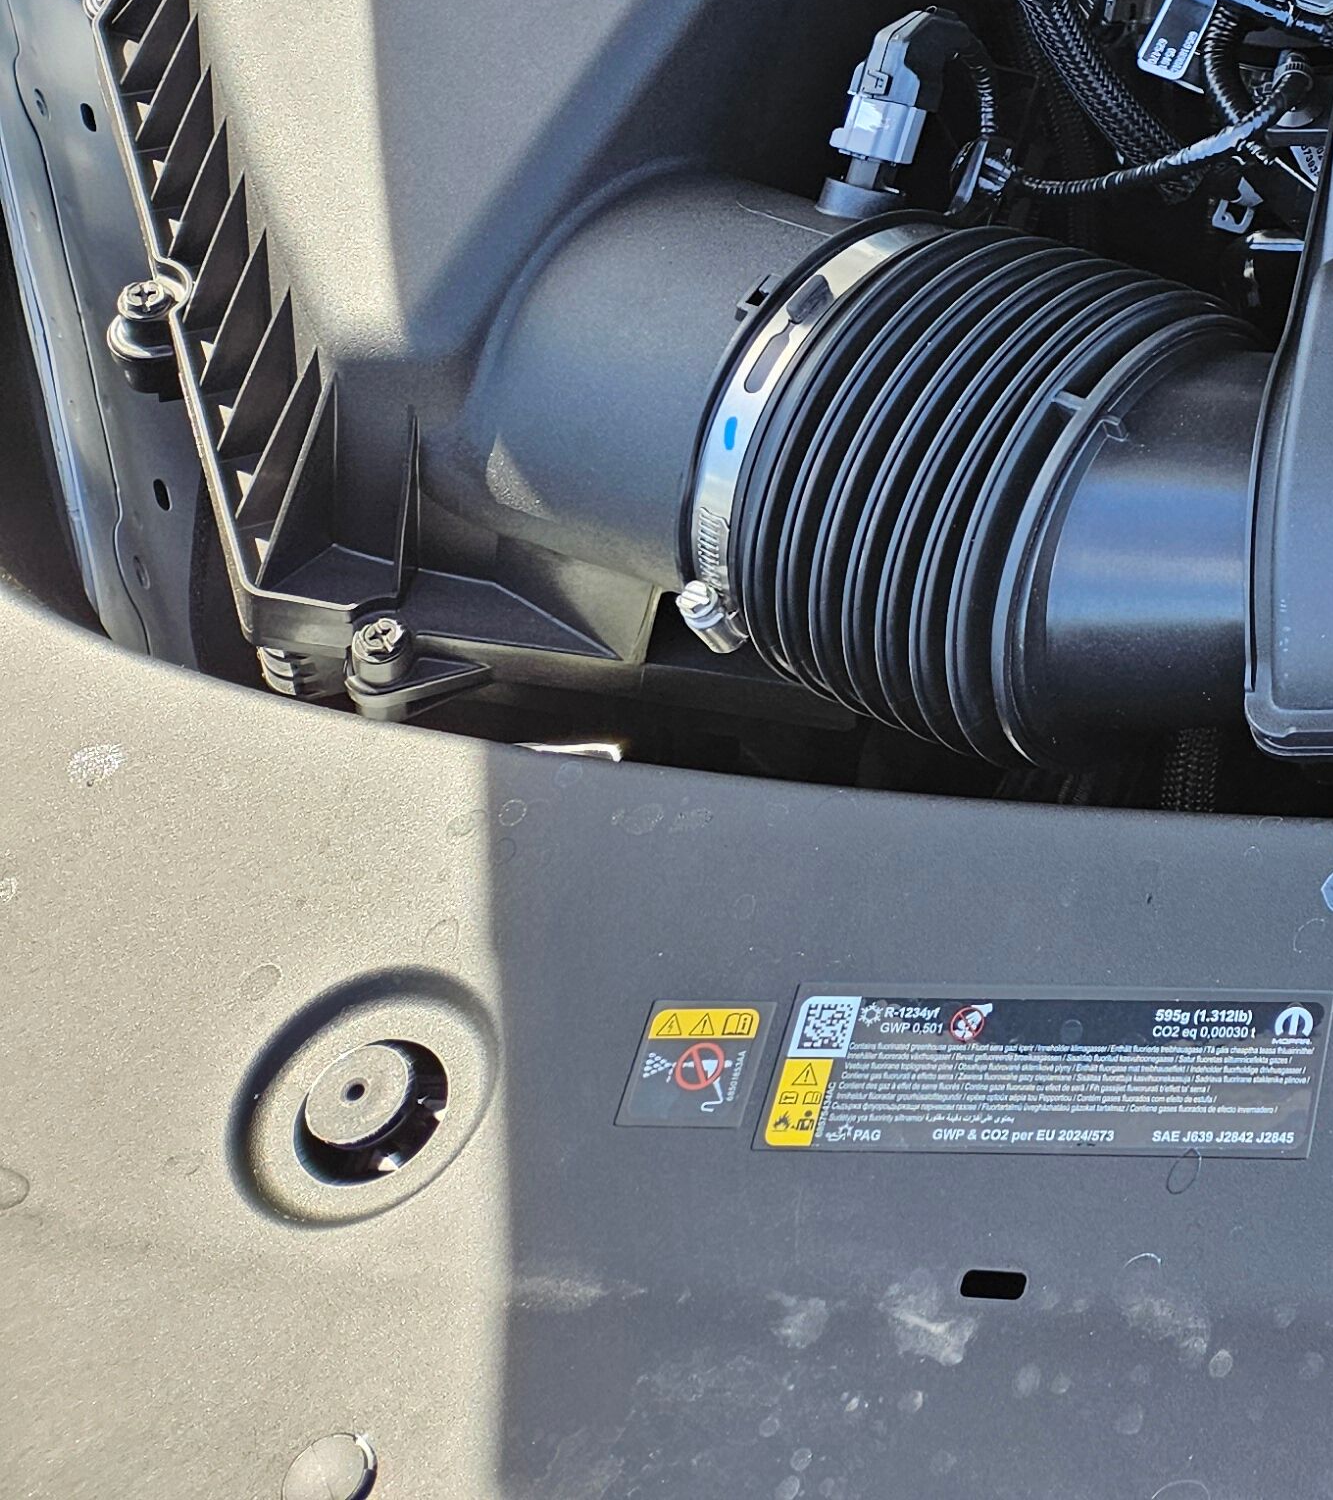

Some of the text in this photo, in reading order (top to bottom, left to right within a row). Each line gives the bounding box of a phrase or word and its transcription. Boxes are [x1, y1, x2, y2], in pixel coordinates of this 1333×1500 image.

[884, 1006, 942, 1021] R-1234yf
[1155, 1009, 1253, 1026] 595g (1.312lb)
[880, 1022, 944, 1036] GWP 0,501
[1152, 1026, 1179, 1037] CO2
[1181, 1028, 1197, 1040] eq
[1199, 1026, 1249, 1039] 0,00030
[853, 1129, 882, 1141] PAG
[932, 1128, 1116, 1143] GWP & CO2 per EU 2024/573
[1152, 1130, 1296, 1143] SAE J639 J2842 J2845
